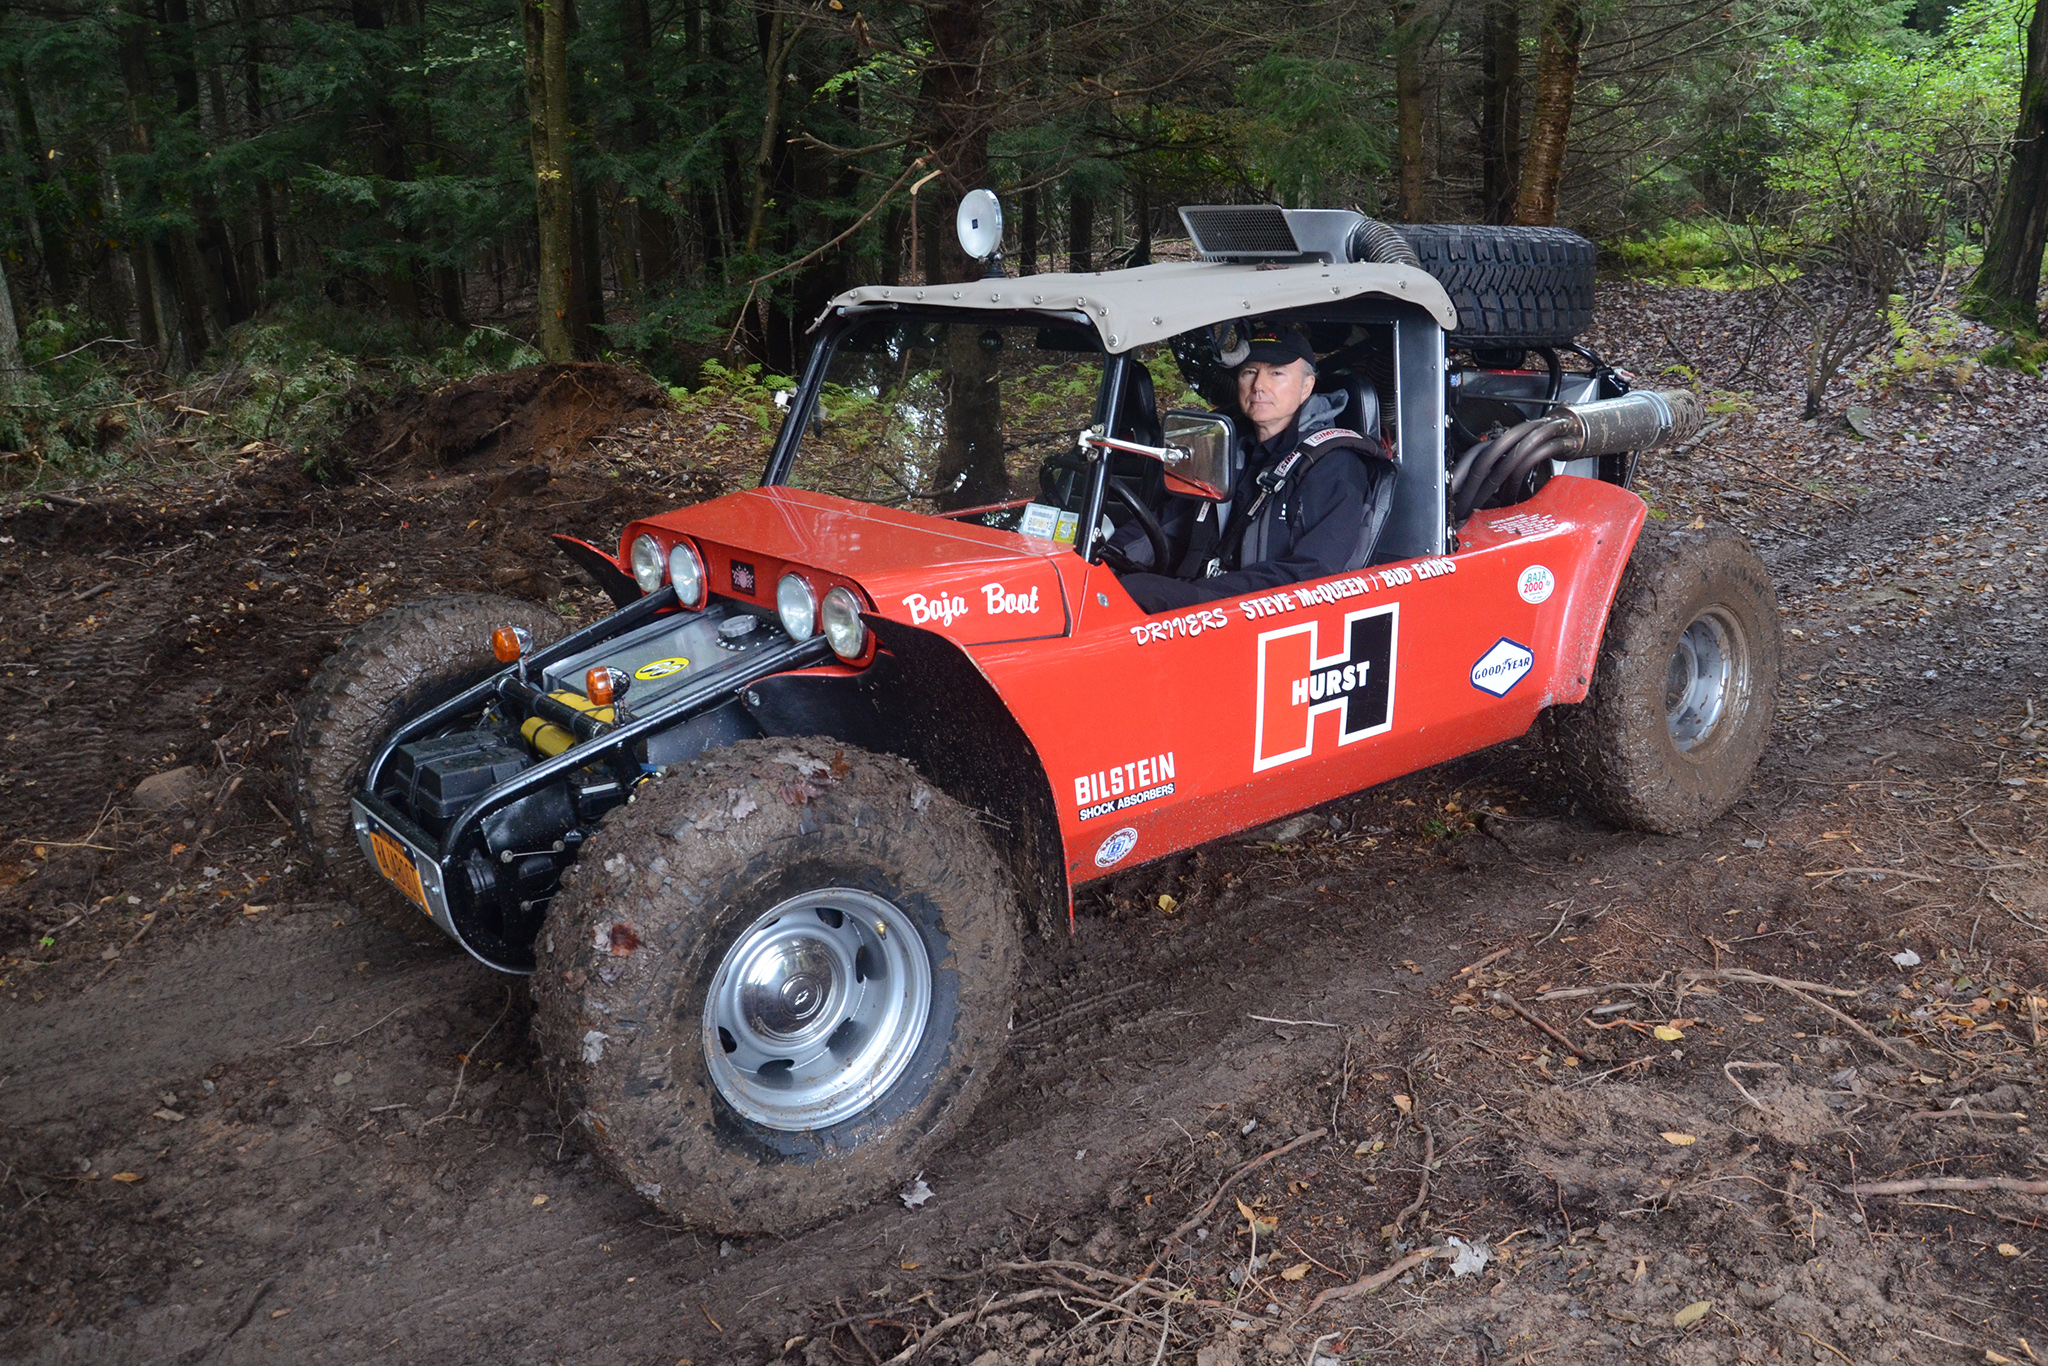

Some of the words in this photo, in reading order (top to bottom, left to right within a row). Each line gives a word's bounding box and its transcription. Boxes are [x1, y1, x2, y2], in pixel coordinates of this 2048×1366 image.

[1523, 581, 1543, 593] 2000
[1526, 571, 1547, 583] BAJA
[902, 591, 969, 627] Baja
[981, 582, 1040, 615] Boot
[1130, 608, 1228, 645] DRIVERS
[1239, 592, 1296, 621] STEVE
[1294, 576, 1370, 608] McQUEEN
[1378, 567, 1413, 588] BUD
[1411, 557, 1457, 581] EKINS
[1291, 660, 1370, 706] HURST
[1474, 656, 1531, 680] GOODYEAR
[1074, 751, 1176, 806] BILSTEIN
[1079, 800, 1116, 821] SHOCK
[1117, 783, 1175, 810] ABSORBERS
